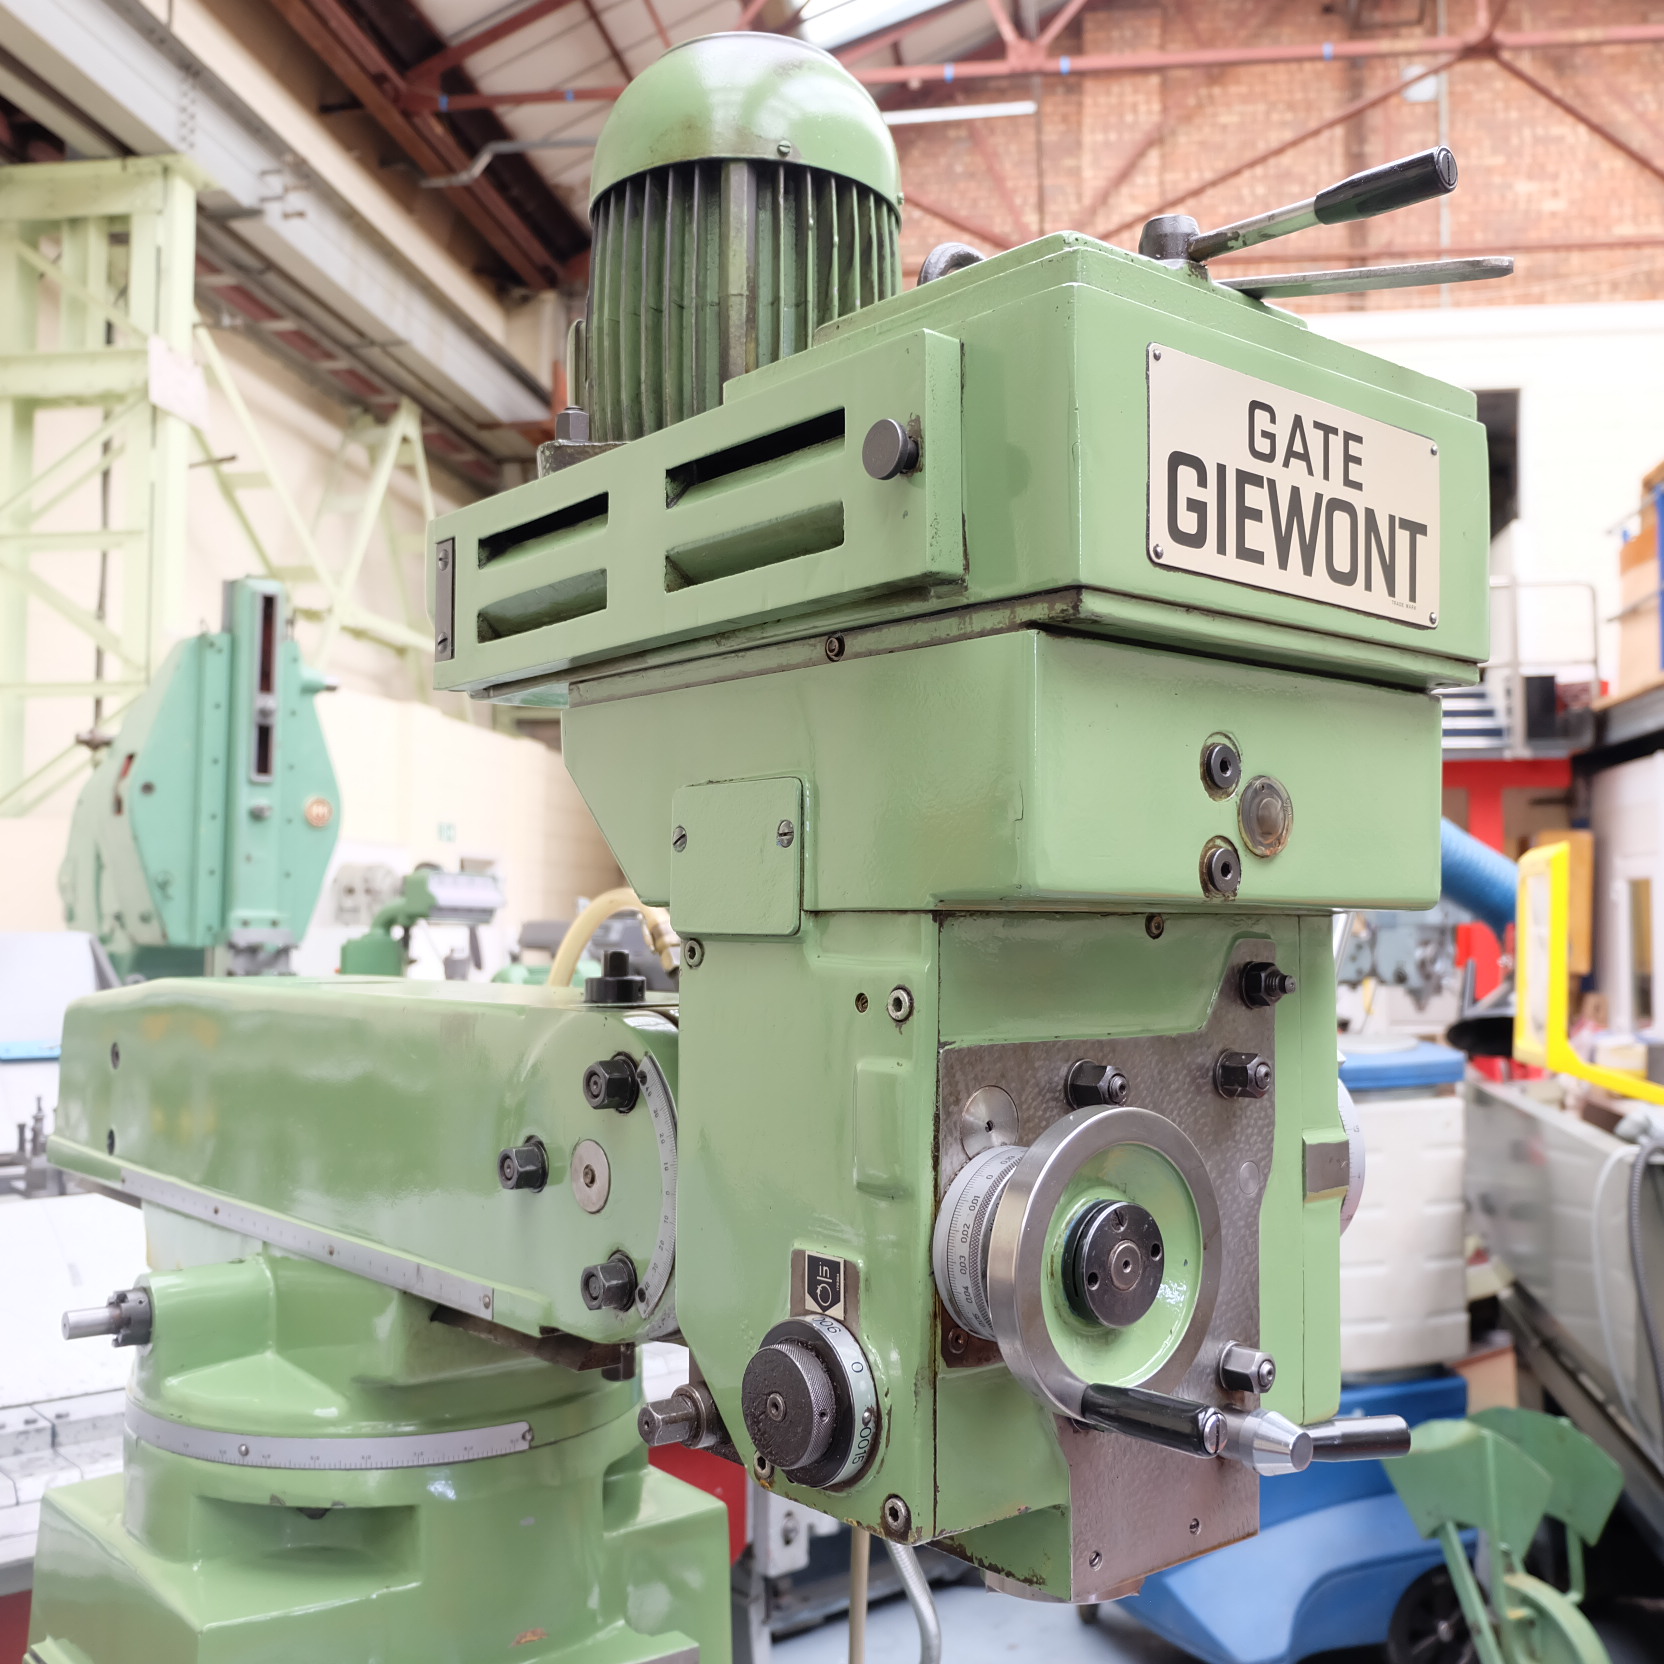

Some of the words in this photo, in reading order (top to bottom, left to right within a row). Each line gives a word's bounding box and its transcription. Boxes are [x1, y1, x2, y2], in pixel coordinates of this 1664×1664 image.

[1248, 399, 1364, 492] GATE
[1167, 450, 1428, 603] GIEWONT
[1391, 600, 1405, 608] TRADE
[659, 1132, 666, 1144] 20
[663, 1161, 670, 1172] 10
